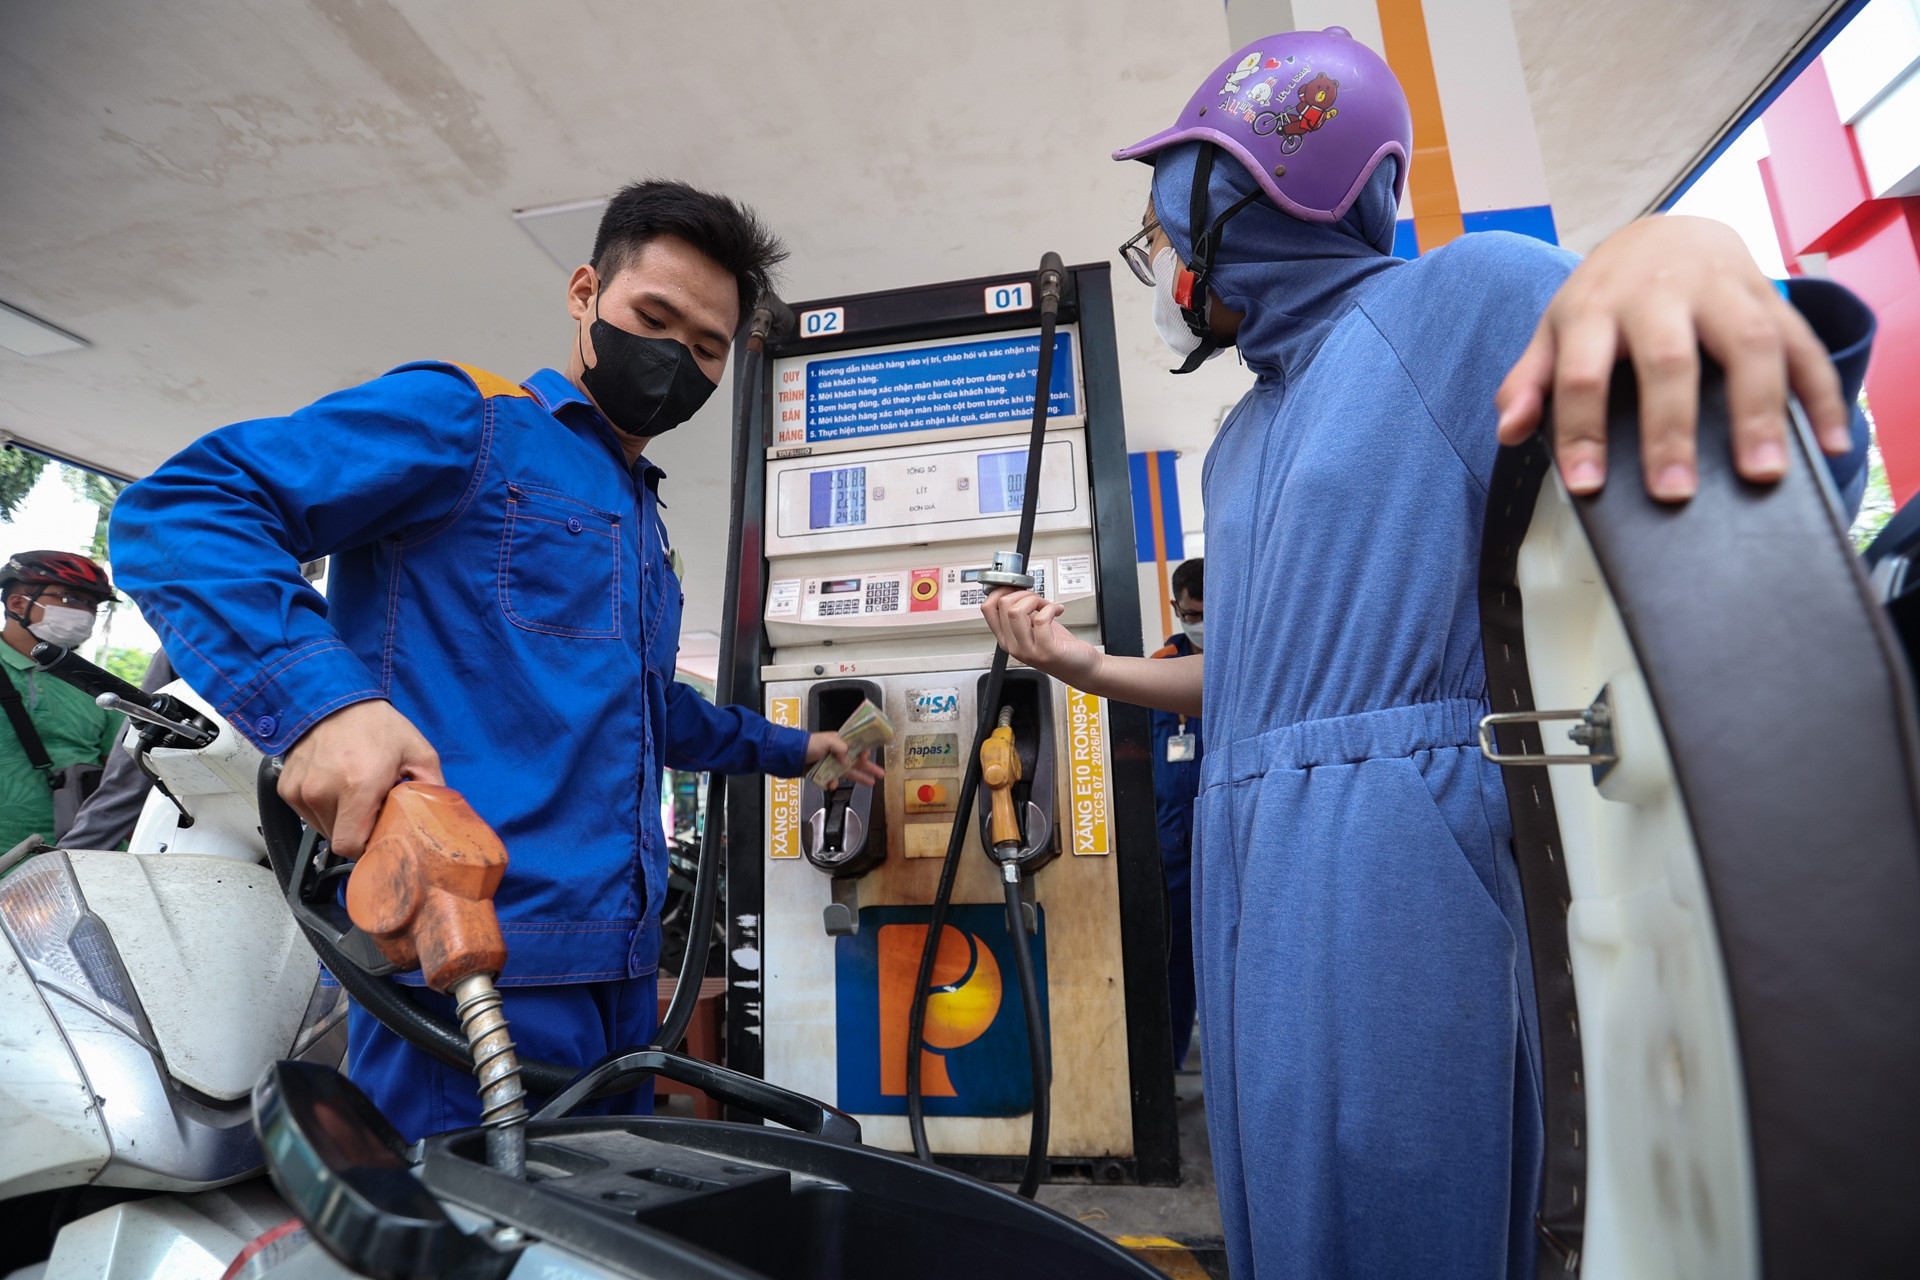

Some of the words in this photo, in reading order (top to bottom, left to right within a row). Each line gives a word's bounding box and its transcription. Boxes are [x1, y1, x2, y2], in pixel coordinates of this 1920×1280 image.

[996, 287, 1022, 308] 01
[807, 312, 837, 333] 02
[783, 371, 800, 382] QUY
[778, 390, 804, 402] TRÌNH
[782, 409, 800, 422] BÁN
[779, 429, 804, 442] HÀNG
[778, 448, 810, 457] TATSUNO
[916, 486, 928, 494] LÍT
[1072, 689, 1089, 760] RON95-V
[1090, 712, 1102, 766] 2026/PLX
[908, 745, 942, 757] napas
[1076, 765, 1092, 796] E10
[1093, 775, 1103, 789] 07
[790, 784, 798, 797] 07
[789, 800, 798, 830] TCCS
[1094, 791, 1104, 825] TCCS
[772, 807, 788, 854] XĂNG
[1076, 800, 1095, 850] XĂNG
